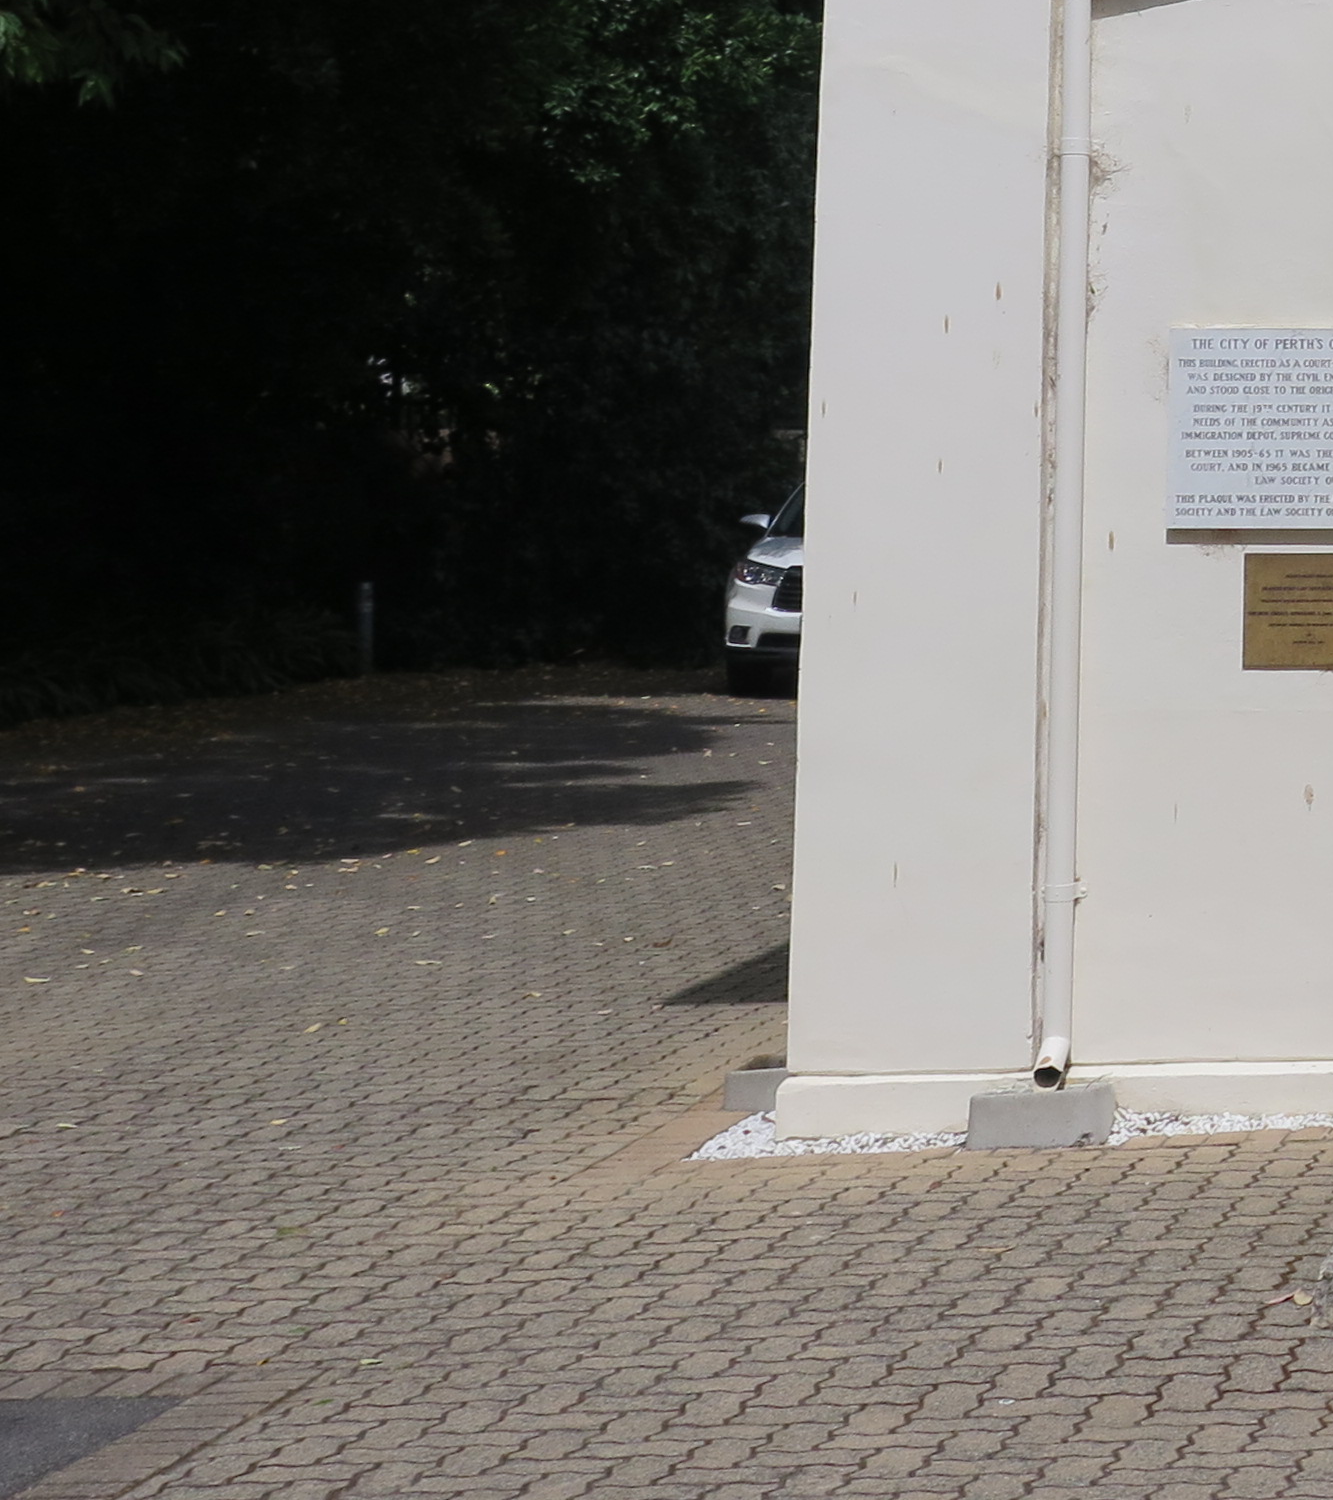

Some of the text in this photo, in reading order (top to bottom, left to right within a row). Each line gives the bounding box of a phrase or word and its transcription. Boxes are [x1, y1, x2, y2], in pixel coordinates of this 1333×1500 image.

[1192, 338, 1214, 350] THE
[1220, 338, 1250, 350] CITY
[1254, 338, 1270, 350] OF
[1275, 338, 1323, 350] PERTH'S
[1178, 358, 1196, 368] THIS
[1199, 358, 1238, 368] BUILDING
[1241, 358, 1276, 368] ERECTED
[1279, 358, 1290, 368] AS
[1293, 358, 1301, 368] A
[1188, 372, 1208, 382] WAS
[1213, 372, 1256, 382] DESIGNED
[1260, 372, 1272, 382] BY
[1276, 372, 1292, 382] THE
[1296, 372, 1320, 382] CIVIL
[1186, 386, 1206, 394] AND
[1210, 386, 1239, 394] STOOD
[1243, 386, 1270, 394] CLOSE
[1275, 386, 1286, 394] TO
[1291, 386, 1306, 394] THE
[1194, 404, 1227, 413] DURING
[1232, 404, 1248, 413] THE
[1277, 404, 1318, 413] CENTURY
[1322, 404, 1330, 413] IT
[1193, 418, 1220, 426] NEEDS
[1224, 418, 1235, 426] OF
[1241, 418, 1257, 426] THE
[1261, 418, 1318, 426] COMMUNITY
[1322, 418, 1333, 426] AS
[1181, 432, 1242, 440] IMMIGRATION
[1280, 432, 1320, 440] SUPREME
[1186, 450, 1228, 458] BETWEEN
[1232, 450, 1270, 458] 1905-65
[1275, 450, 1284, 458] IT
[1290, 450, 1310, 458] WAS
[1316, 450, 1333, 458] THE
[1228, 462, 1248, 472] AND
[1252, 462, 1262, 472] IN
[1266, 462, 1288, 472] 1965
[1291, 462, 1329, 472] BECAME
[1255, 476, 1276, 484] LAW
[1280, 476, 1320, 484] SOCIETY
[1176, 494, 1195, 503] THIS
[1199, 494, 1233, 503] PLAQUE
[1236, 494, 1256, 503] WAS
[1260, 494, 1294, 503] ERECTED
[1298, 494, 1310, 503] BY
[1314, 494, 1329, 503] THE
[1175, 508, 1214, 516] SOCIETY
[1216, 508, 1236, 516] AND
[1240, 508, 1257, 516] THE
[1260, 508, 1282, 516] LAW
[1285, 508, 1323, 516] SOCIETY
